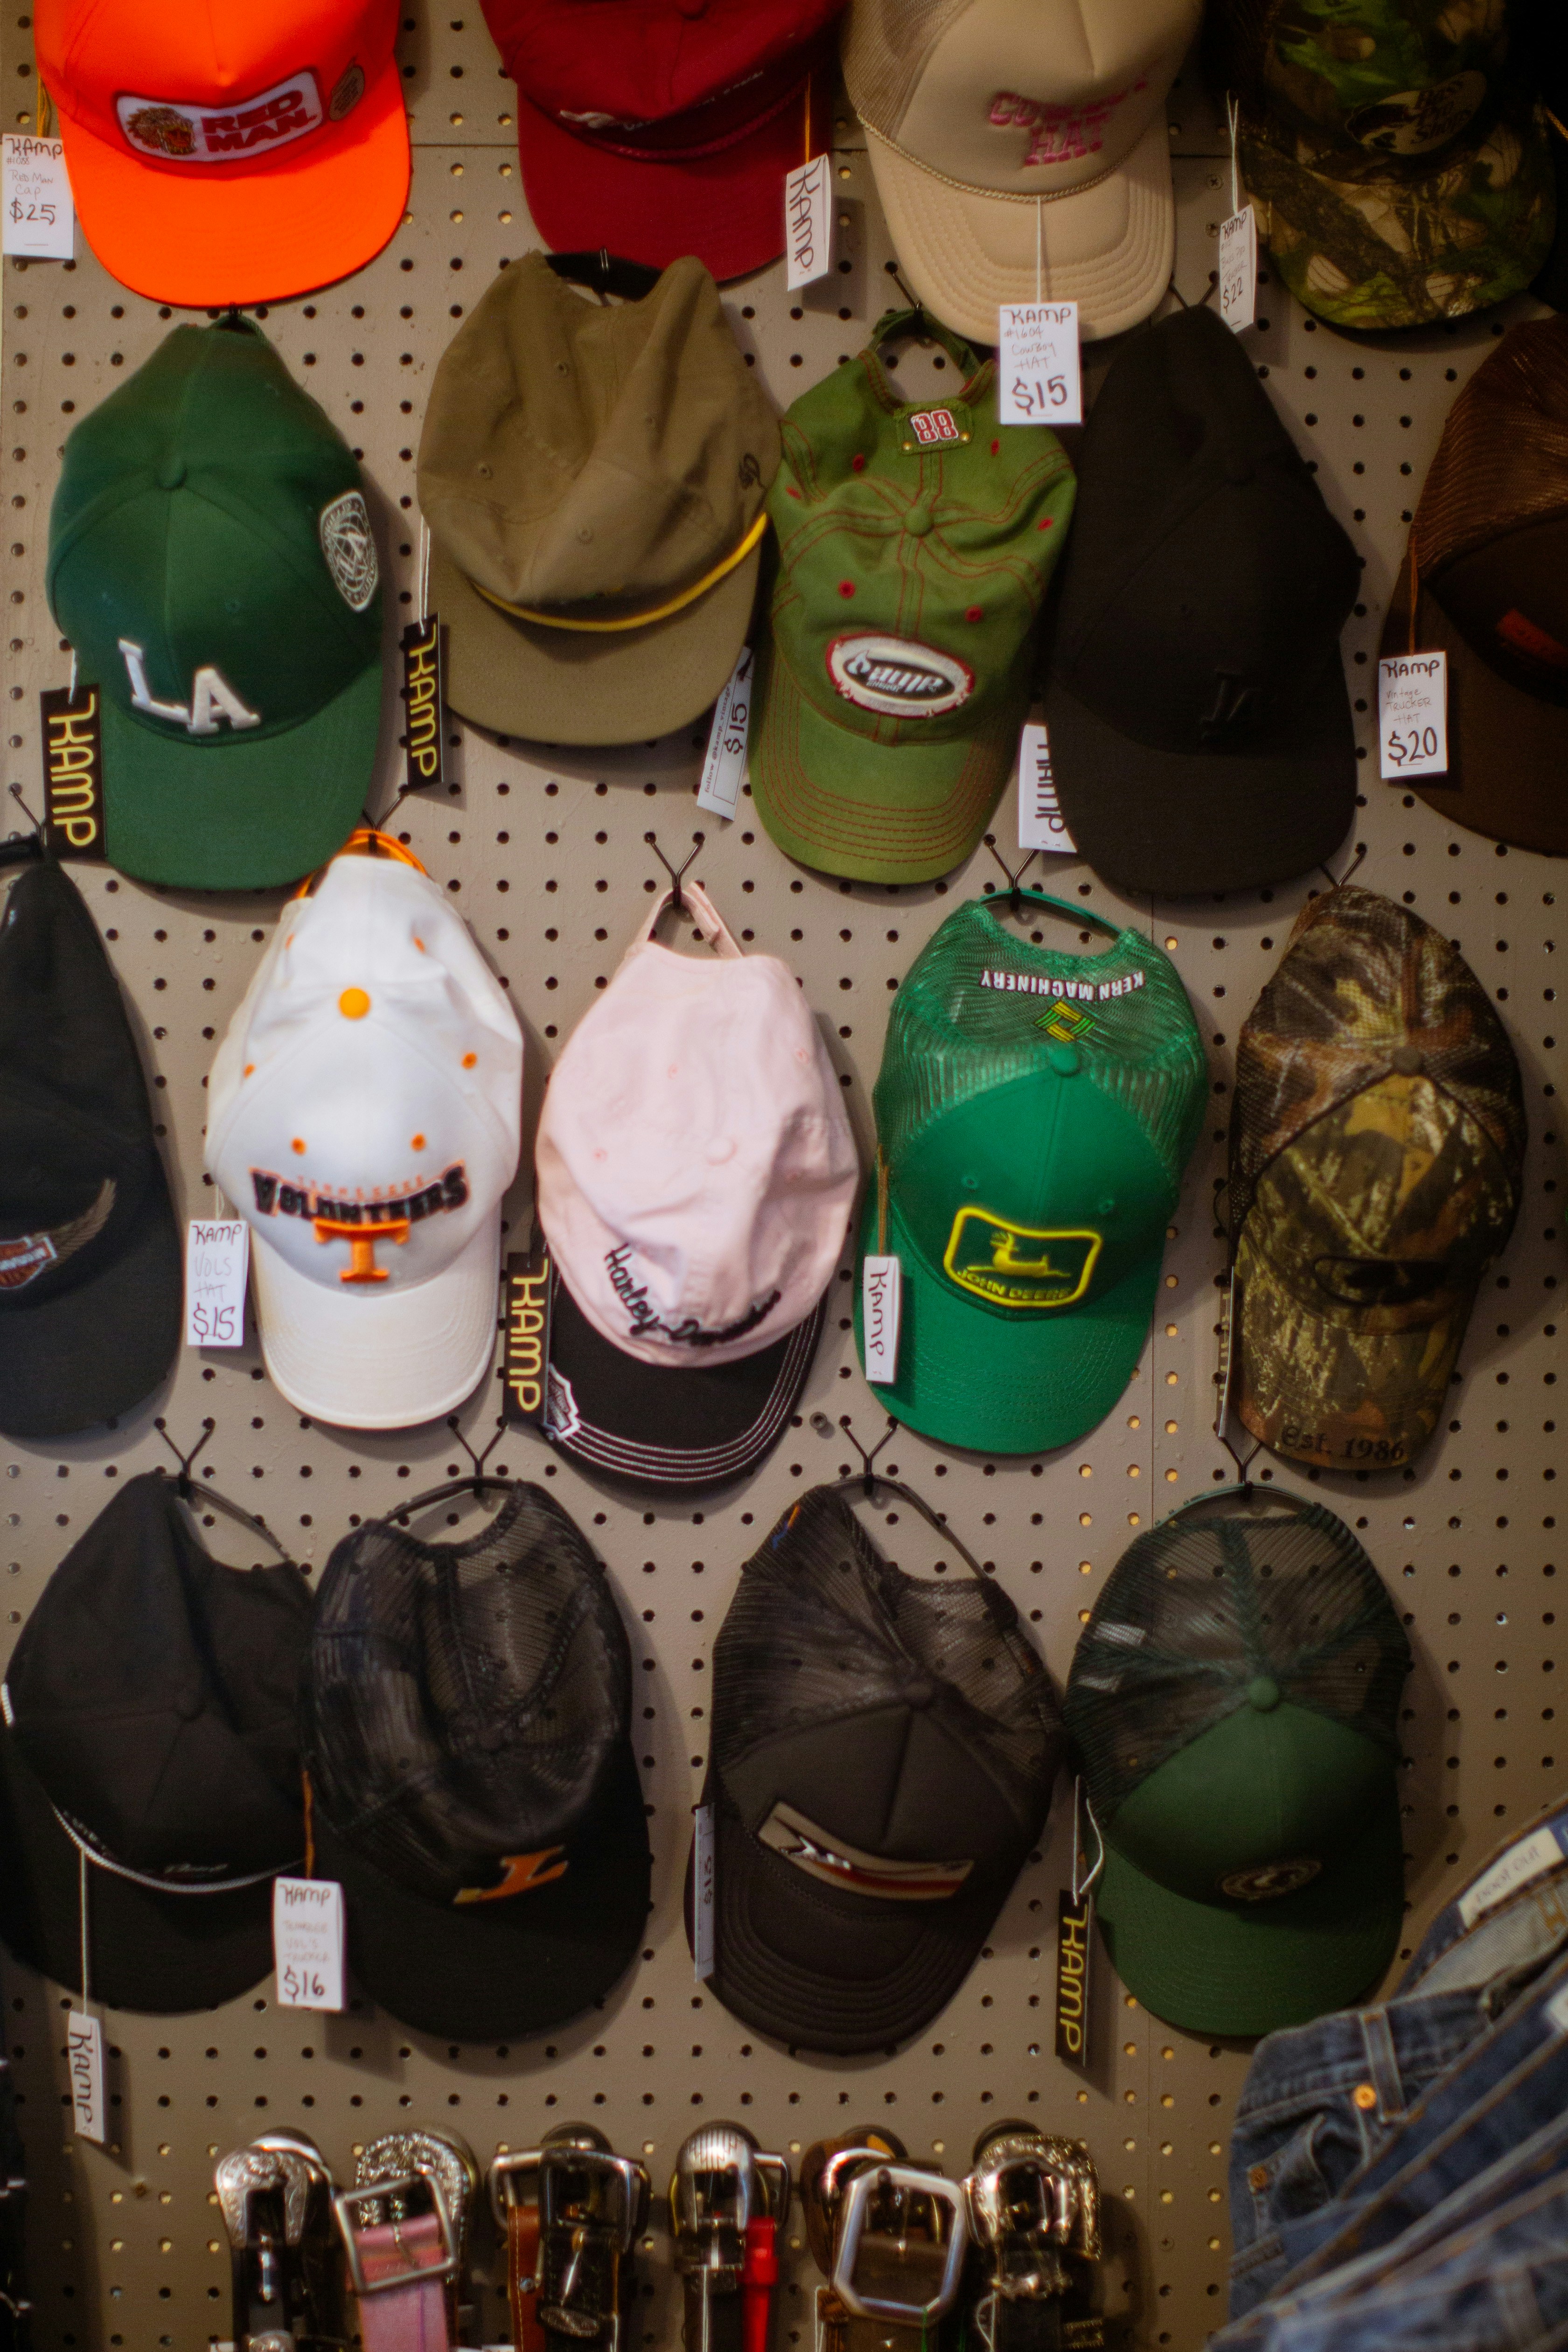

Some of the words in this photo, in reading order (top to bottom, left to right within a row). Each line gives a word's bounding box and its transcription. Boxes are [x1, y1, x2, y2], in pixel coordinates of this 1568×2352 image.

[201, 90, 304, 134] RED
[205, 107, 309, 153] MAN
[6, 138, 63, 160] KAMP
[1023, 112, 1111, 168] HAT
[9, 197, 56, 226] $25
[789, 158, 820, 269] KAMP
[1222, 211, 1247, 240] KAMP
[1223, 276, 1243, 314] $22
[1002, 307, 1072, 325] KAMP
[1014, 355, 1051, 372] HAT
[1011, 375, 1068, 417] $15
[910, 409, 959, 445] 88
[118, 638, 262, 736] LA
[1381, 659, 1440, 678] KAMP
[409, 623, 438, 777] KAMP
[1385, 697, 1432, 712] TRUCKER
[1393, 713, 1421, 725] HAT
[724, 703, 748, 756] $15
[1388, 726, 1437, 767] $20
[49, 693, 97, 847] KAMP
[704, 763, 715, 794] follow
[981, 970, 1095, 1002] MACHINERY
[1097, 970, 1144, 1001] KERN
[192, 1224, 242, 1246] KAMP
[313, 1217, 411, 1283] T
[604, 1242, 782, 1347] Harley-D
[868, 1260, 890, 1357] KAMP
[193, 1301, 236, 1343] $15
[509, 1258, 549, 1412] KAMP
[1340, 1437, 1405, 1461] 1986
[279, 1883, 331, 1907] KAMP
[284, 1963, 326, 2004] $16
[1059, 1903, 1088, 2053] KAMP
